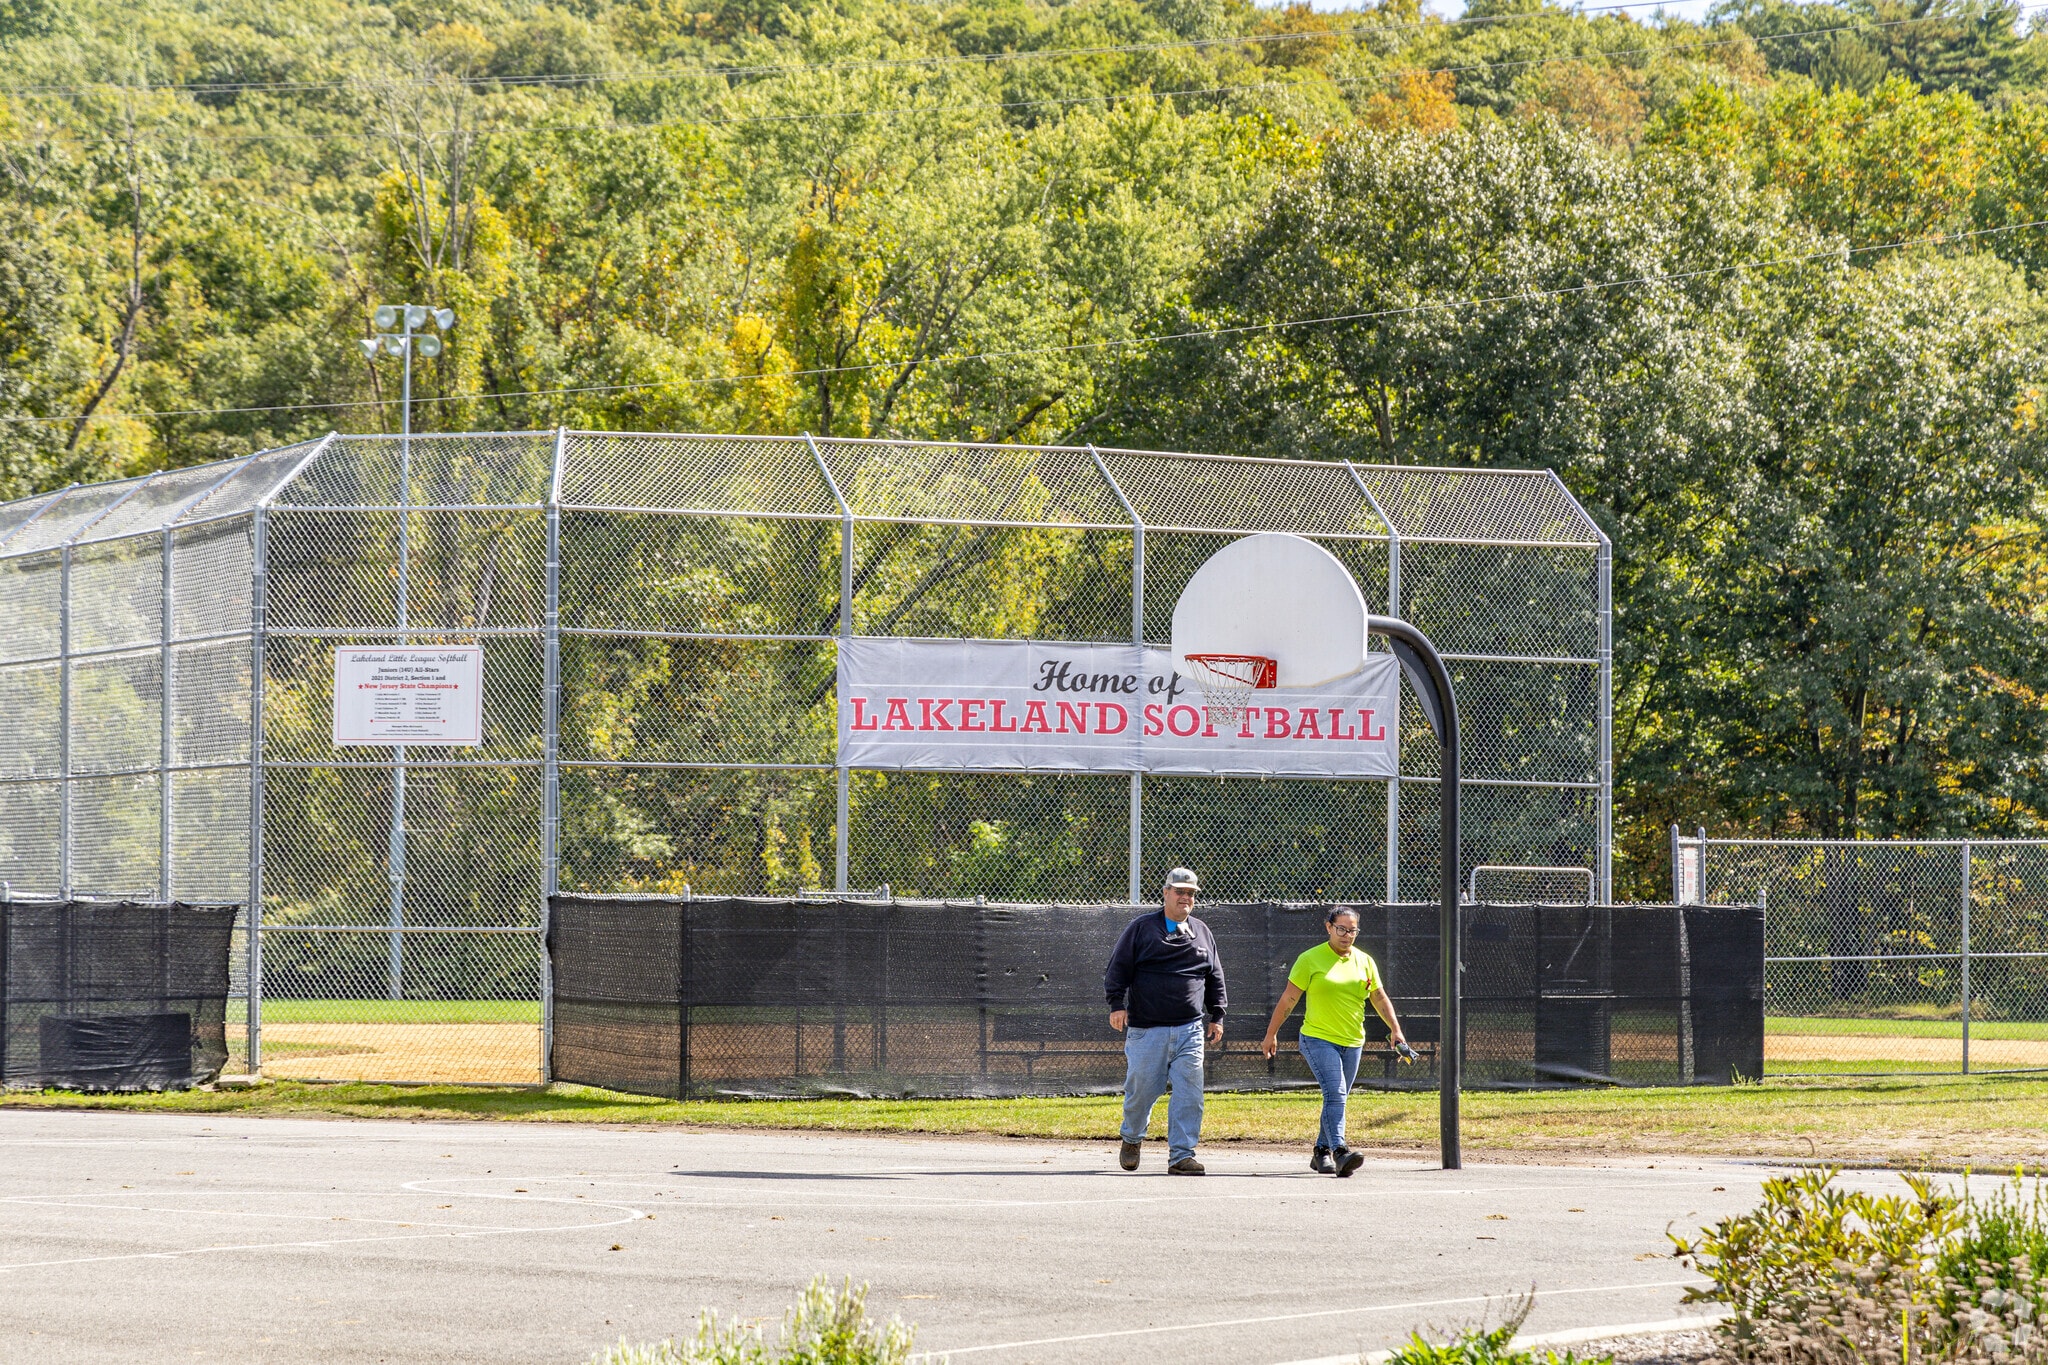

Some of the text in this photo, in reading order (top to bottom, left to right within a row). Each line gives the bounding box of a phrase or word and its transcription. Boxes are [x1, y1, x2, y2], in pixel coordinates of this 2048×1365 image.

[350, 654, 468, 664] Lakeland Little League Softball
[379, 683, 398, 691] Jersey
[417, 682, 453, 691] Champions
[1033, 660, 1139, 694] Home
[849, 697, 1386, 741] LAKELAND SOFTBALL
